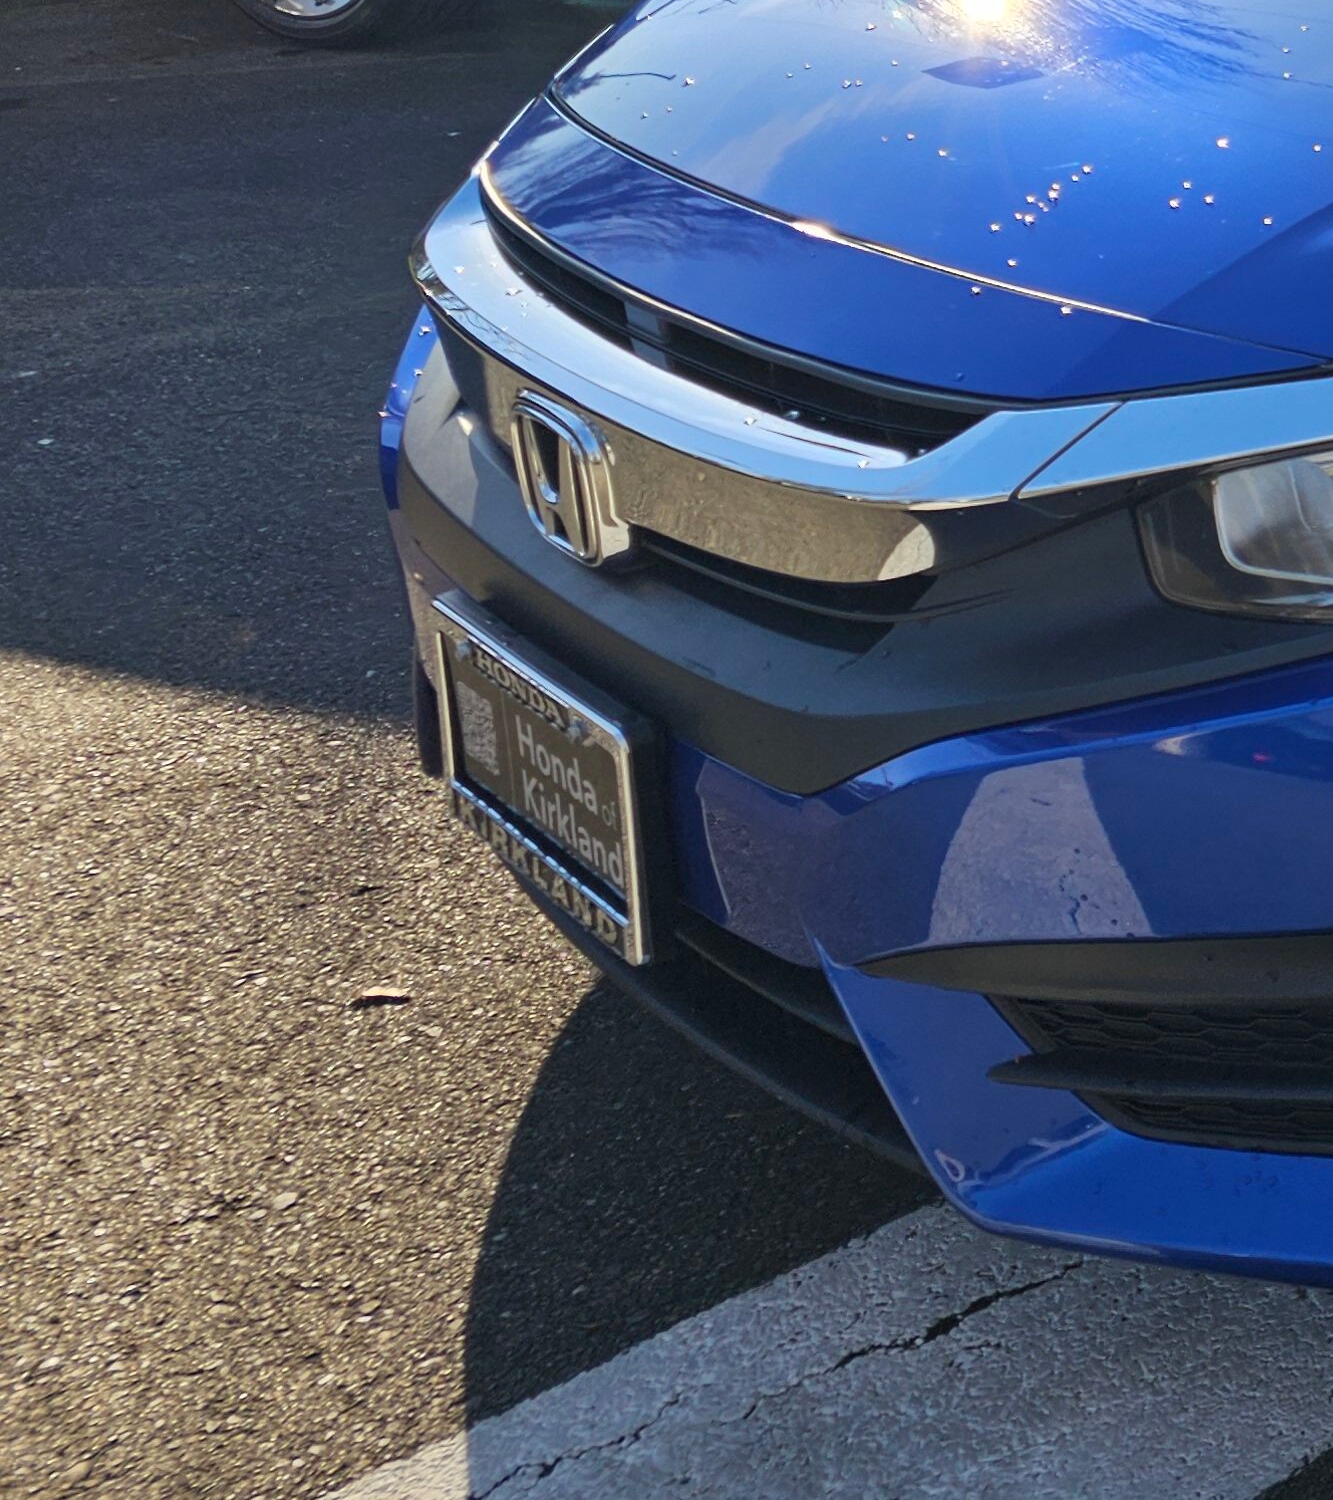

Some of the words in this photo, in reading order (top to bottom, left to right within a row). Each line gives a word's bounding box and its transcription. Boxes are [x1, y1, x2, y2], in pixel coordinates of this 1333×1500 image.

[475, 647, 569, 730] HONDA
[514, 714, 599, 815] Honda
[602, 800, 618, 831] of
[522, 770, 625, 889] Kirkland
[460, 797, 618, 946] KIRKLAND
